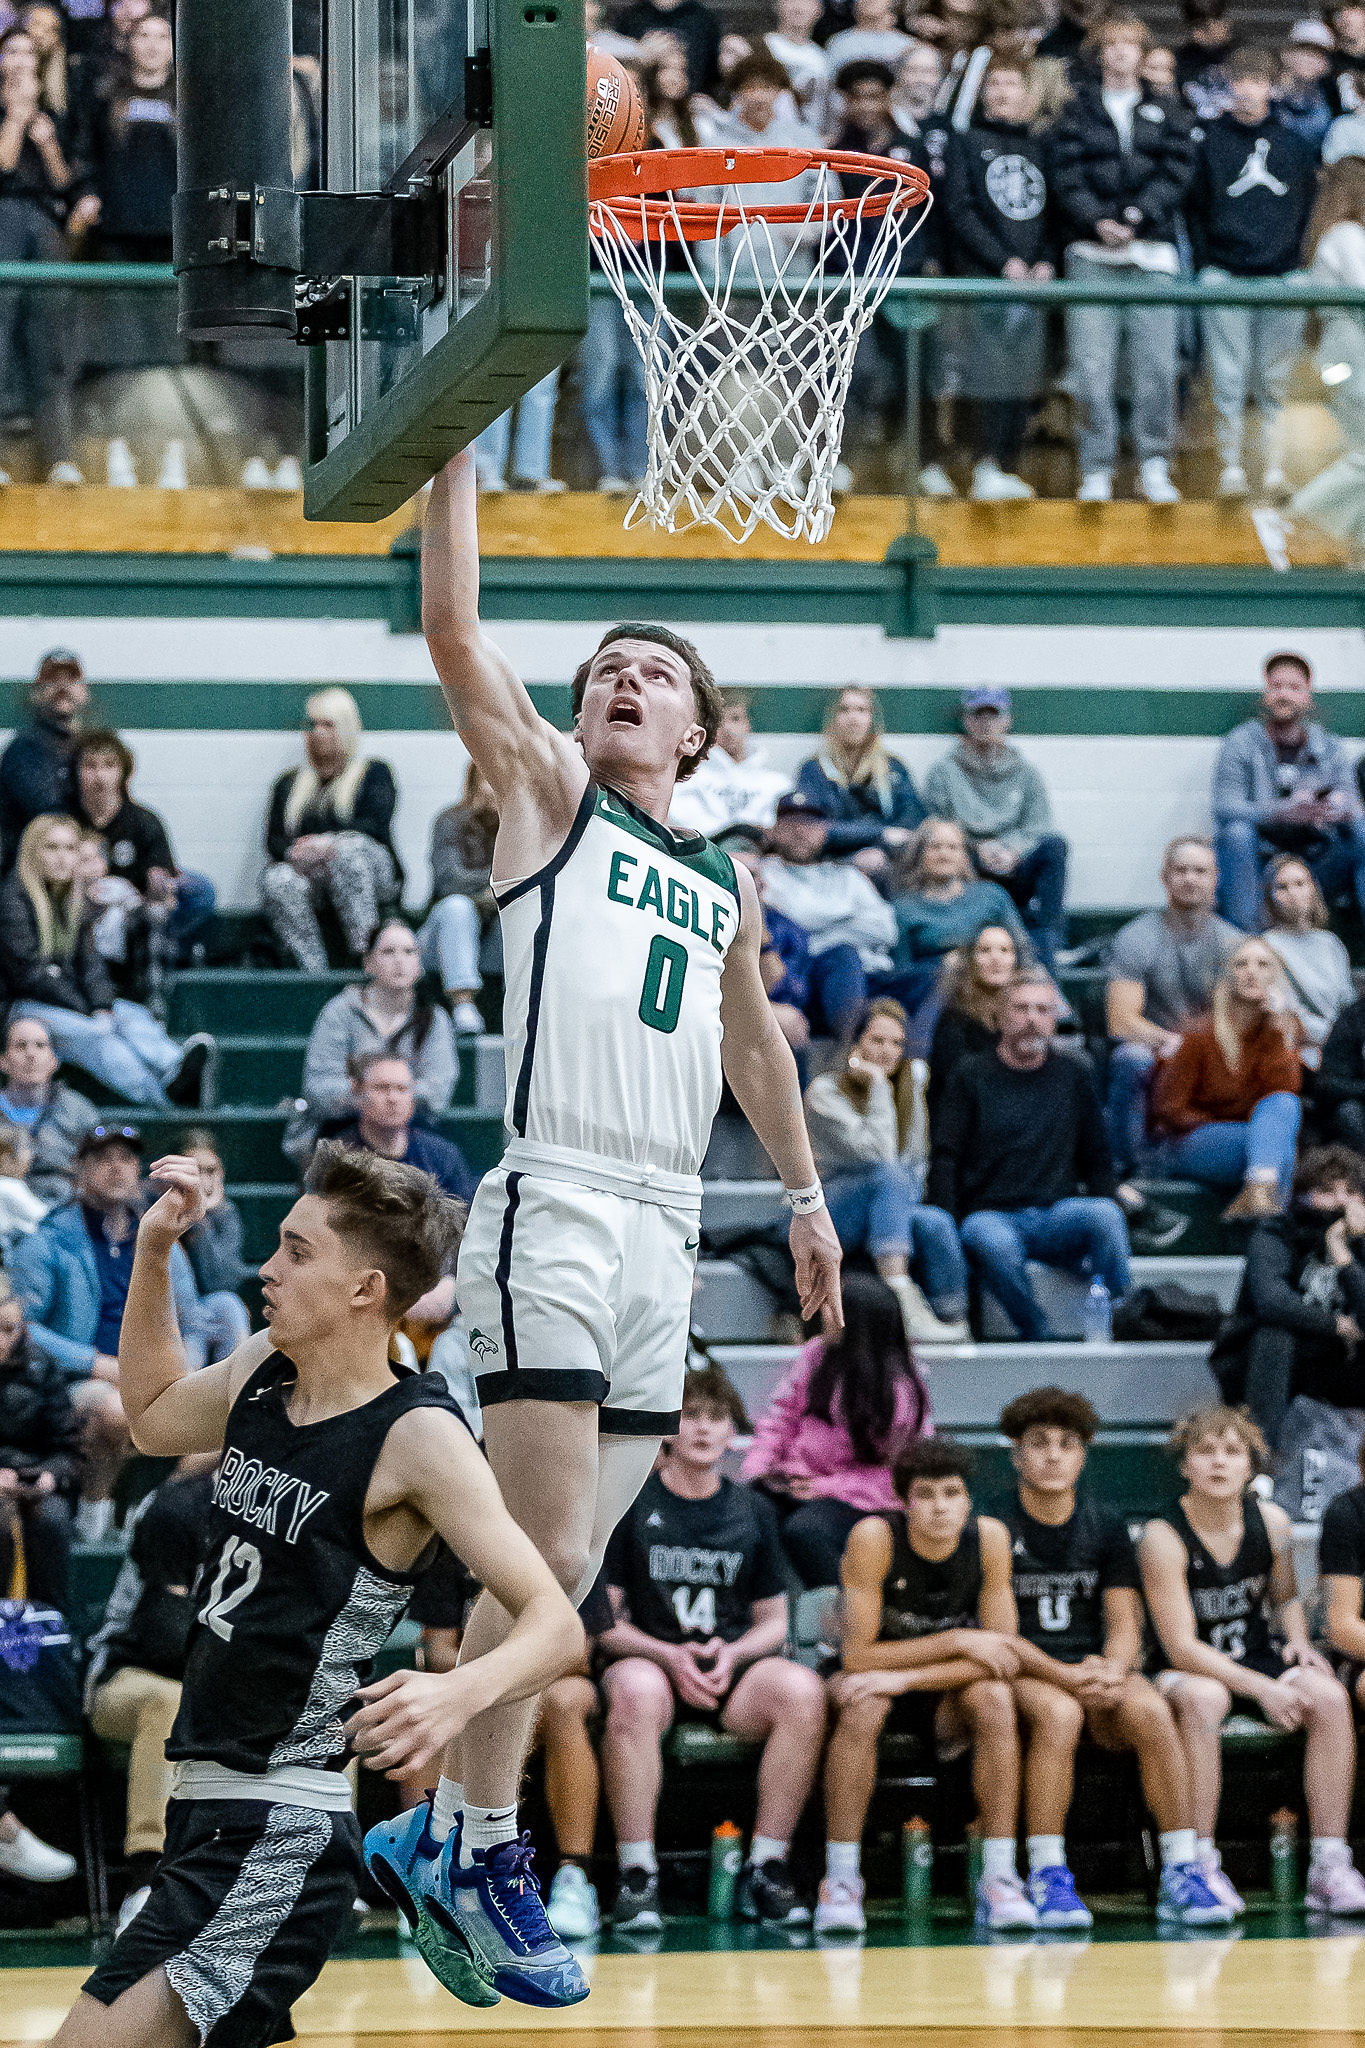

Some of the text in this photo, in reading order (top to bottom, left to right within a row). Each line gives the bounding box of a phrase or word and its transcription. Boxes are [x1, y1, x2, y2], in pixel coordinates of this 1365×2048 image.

[588, 71, 620, 159] PRECISIO
[608, 851, 730, 955] EAGLE
[638, 934, 689, 1034] 0
[211, 1446, 330, 1544] ROCKY
[197, 1535, 262, 1642] 12
[671, 1586, 716, 1634] 14
